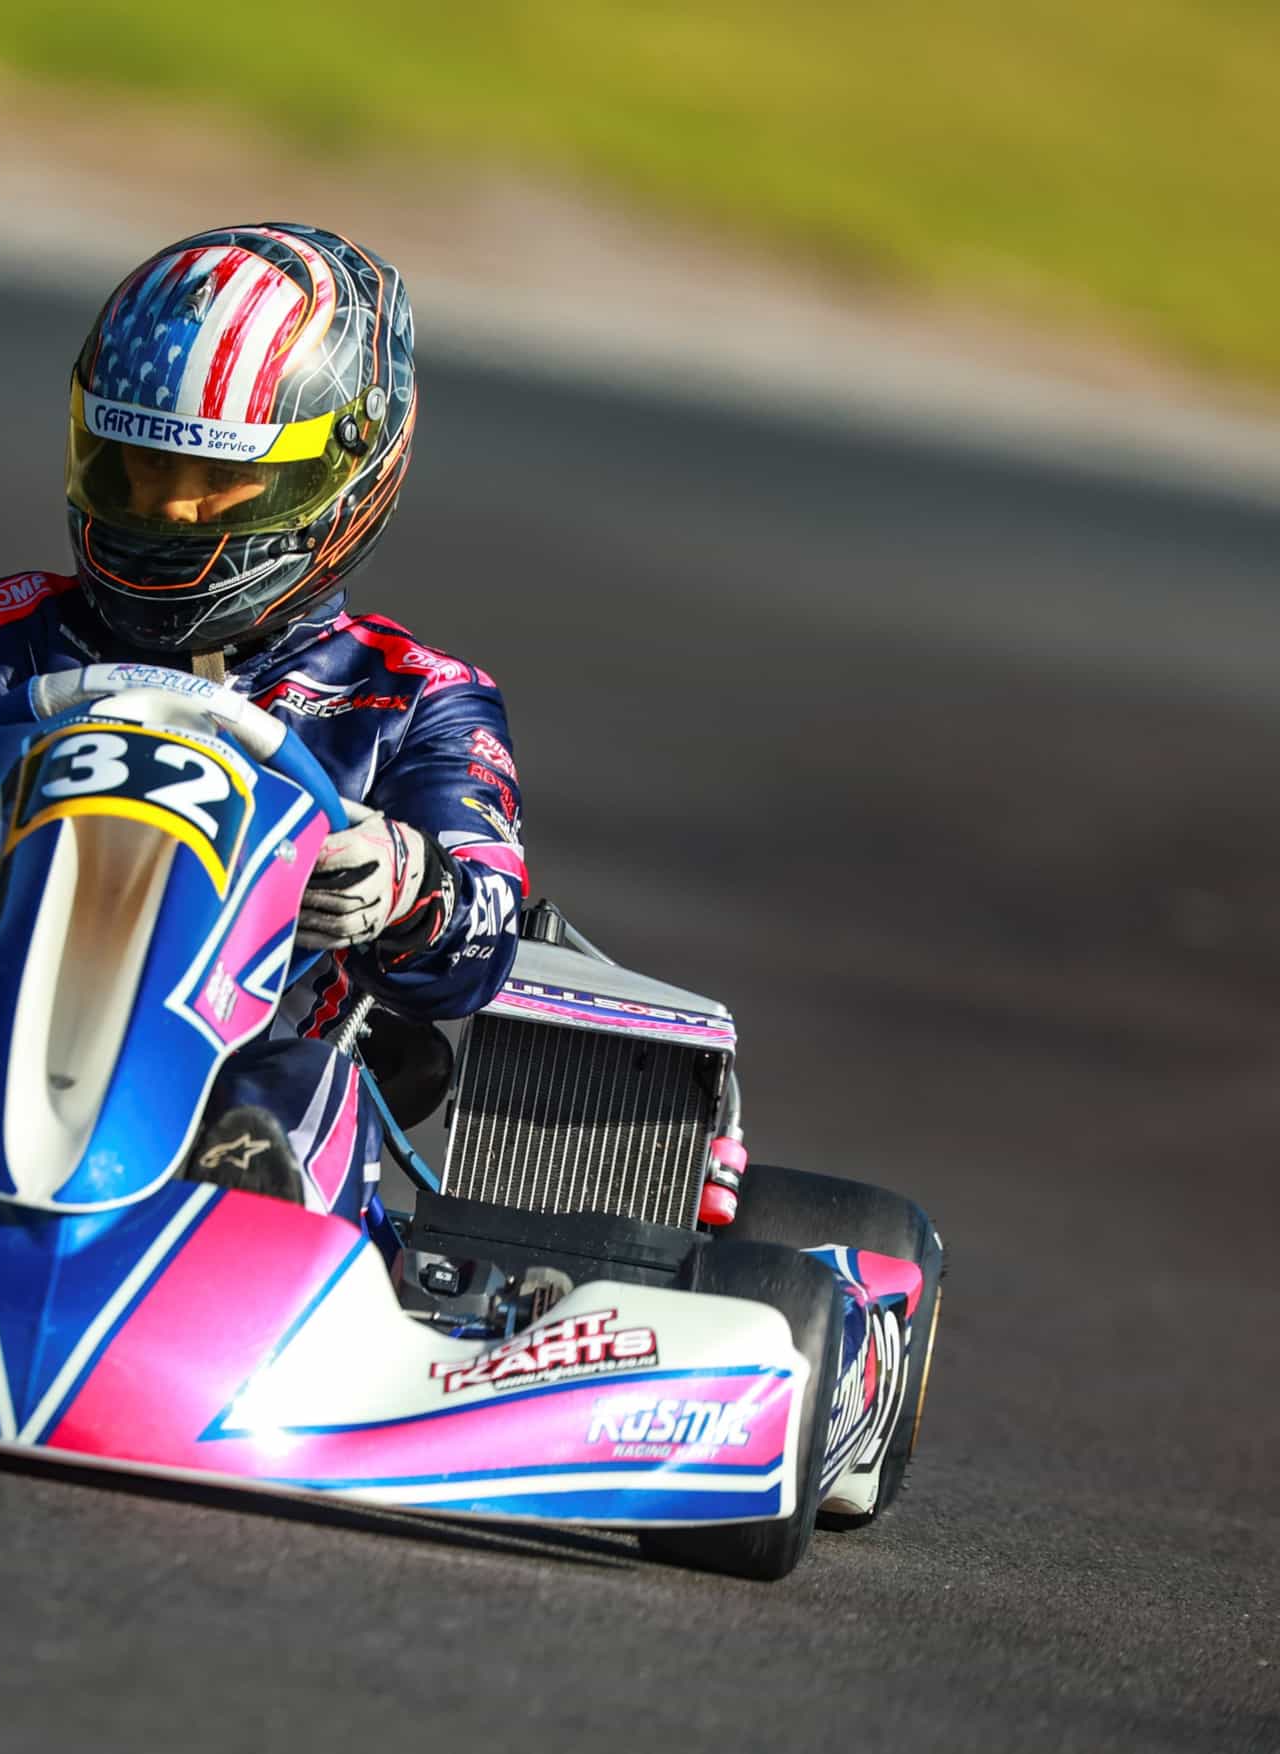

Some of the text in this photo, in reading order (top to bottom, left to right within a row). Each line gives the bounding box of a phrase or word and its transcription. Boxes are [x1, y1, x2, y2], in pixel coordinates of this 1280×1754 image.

[95, 404, 203, 447] CARTER'S
[207, 440, 257, 454] service
[209, 427, 238, 441] tyre
[40, 733, 231, 841] 32
[443, 1326, 658, 1393] KARTS
